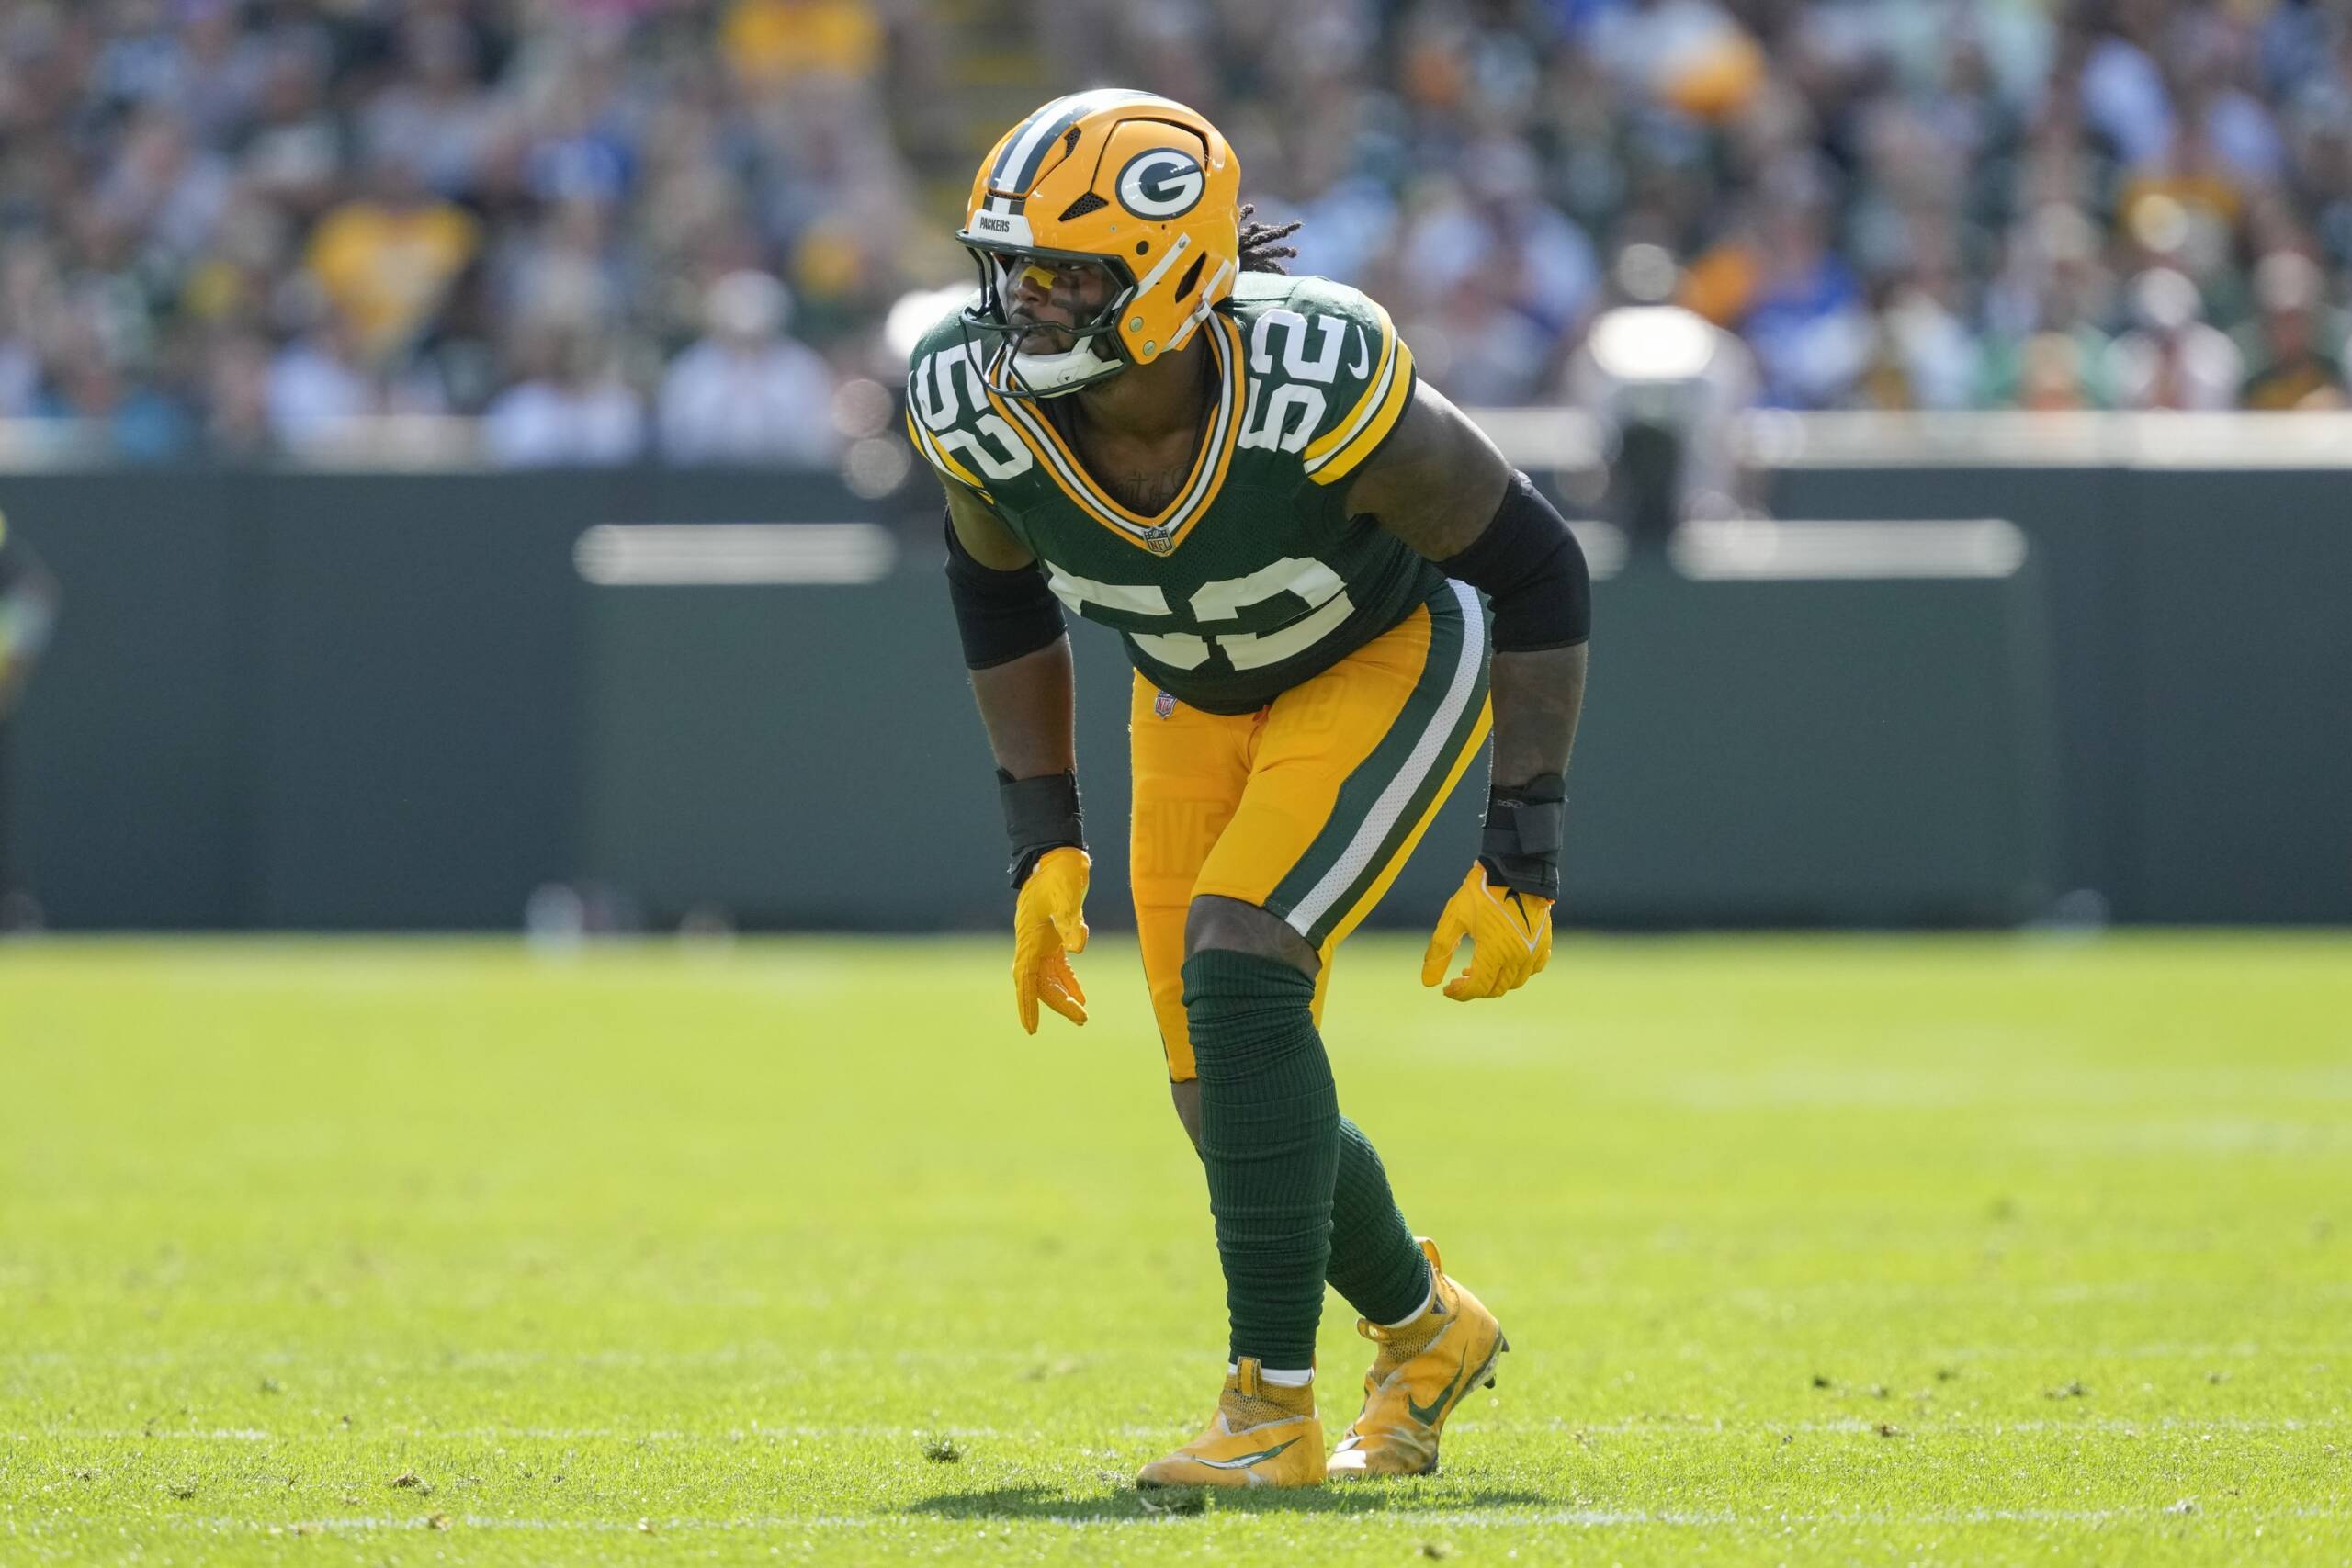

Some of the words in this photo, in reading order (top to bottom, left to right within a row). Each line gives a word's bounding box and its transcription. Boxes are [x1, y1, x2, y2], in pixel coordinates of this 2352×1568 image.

[1120, 151, 1204, 217] G
[980, 217, 1010, 232] PACKERS
[916, 339, 1033, 480] 52
[1238, 310, 1347, 453] 52
[1148, 539, 1172, 552] NFL
[1045, 557, 1356, 671] 52
[1158, 698, 1174, 712] NFL
